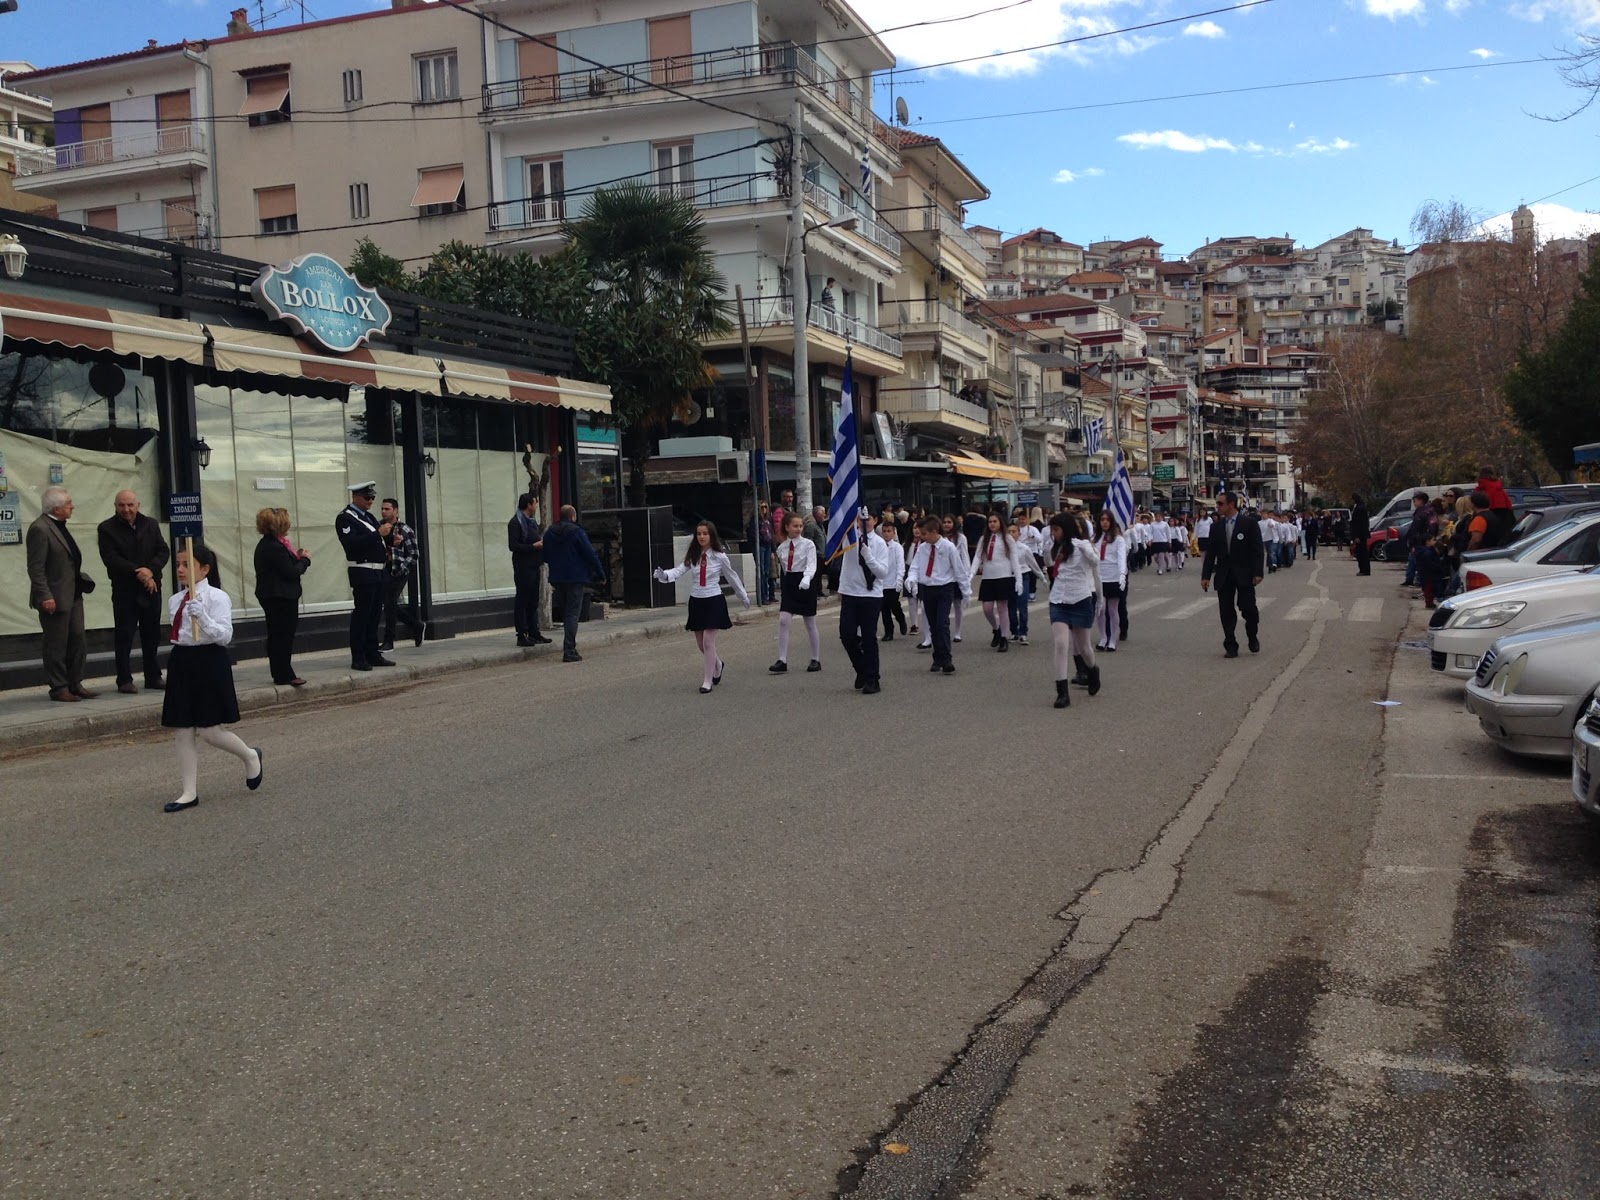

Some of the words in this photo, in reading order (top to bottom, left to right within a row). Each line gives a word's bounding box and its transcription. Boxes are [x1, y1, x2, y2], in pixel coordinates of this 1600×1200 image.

[305, 265, 343, 284] AMERICAN
[319, 315, 345, 327] LOUNGE
[170, 496, 199, 504] ΔΗΜΟΤΙΚΟ
[174, 505, 197, 513] ΣΧΟΛΕΙΟ
